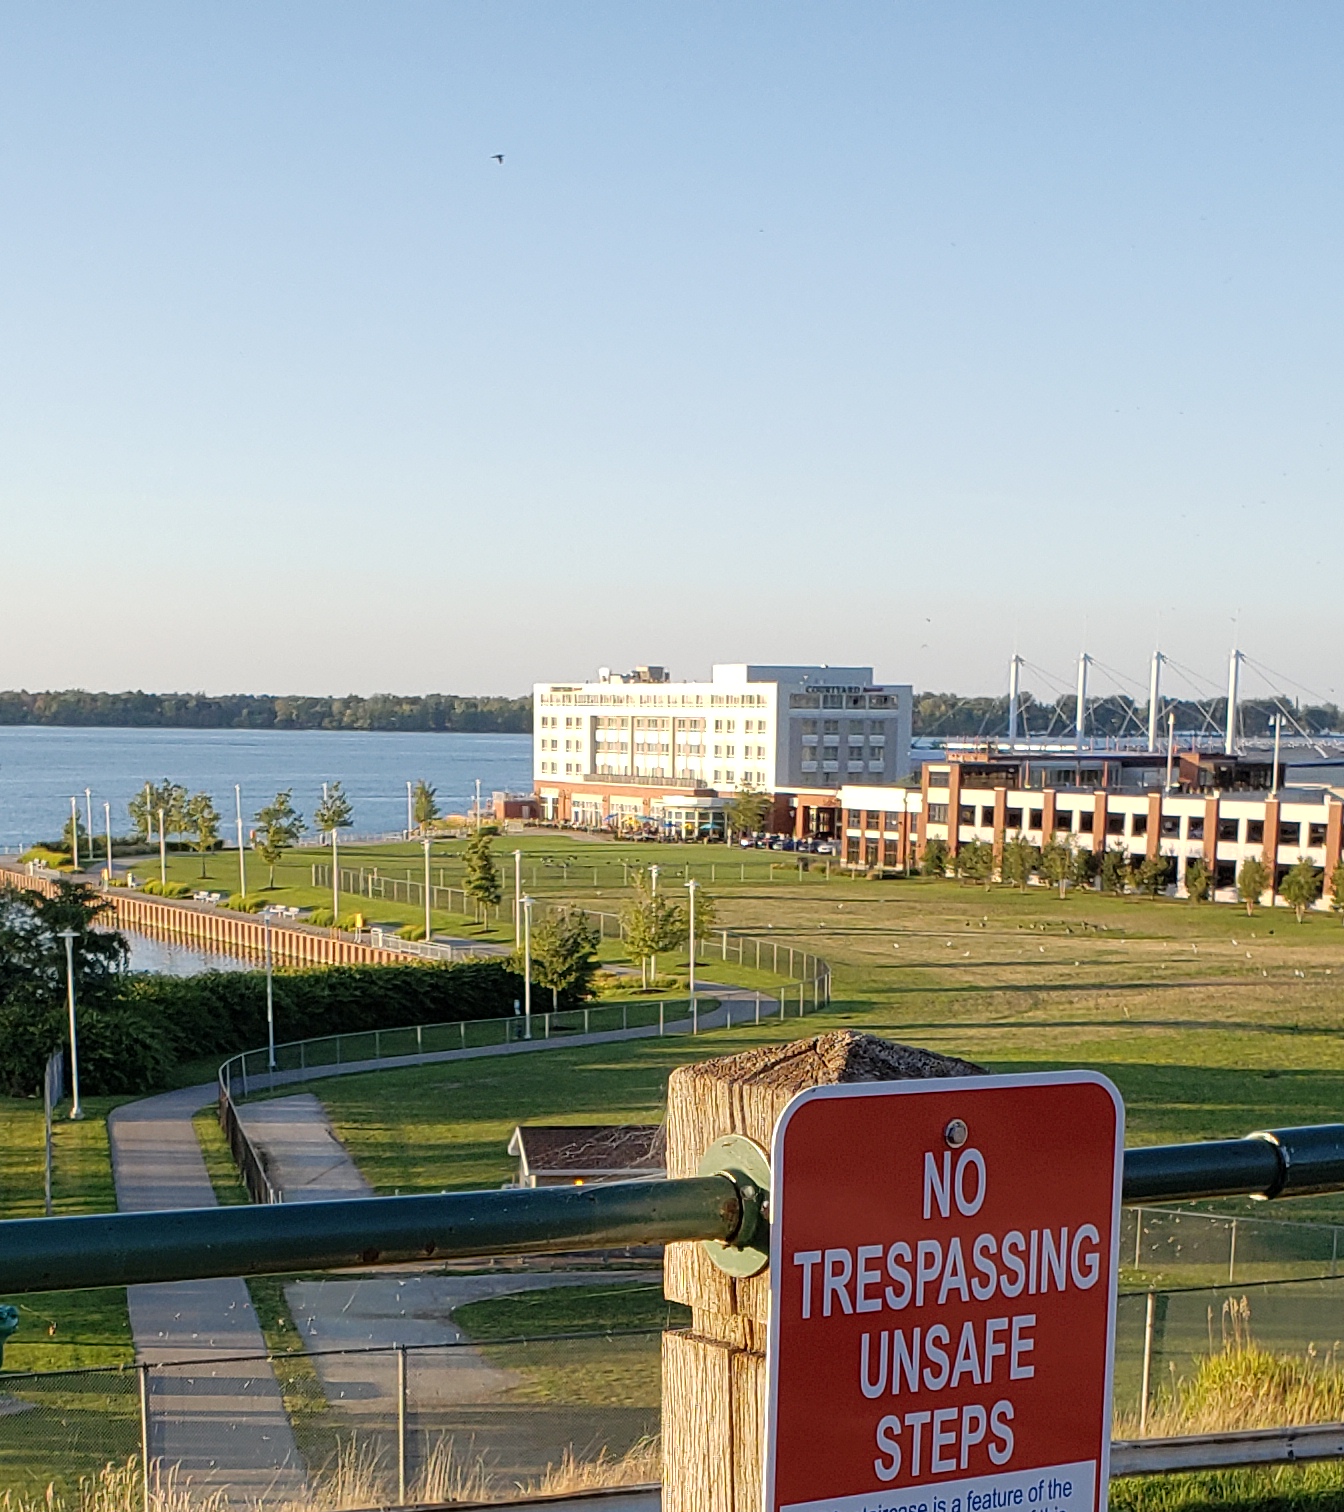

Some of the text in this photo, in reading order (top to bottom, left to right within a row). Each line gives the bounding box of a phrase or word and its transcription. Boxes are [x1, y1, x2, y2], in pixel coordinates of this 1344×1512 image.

[923, 1148, 987, 1219] NO
[794, 1223, 1100, 1318] TRESPASSING
[861, 1314, 1036, 1399] UNSAFE
[874, 1400, 1015, 1481] STEPS
[967, 1488, 1023, 1512] feature
[1028, 1479, 1045, 1502] of
[1048, 1478, 1072, 1500] the
